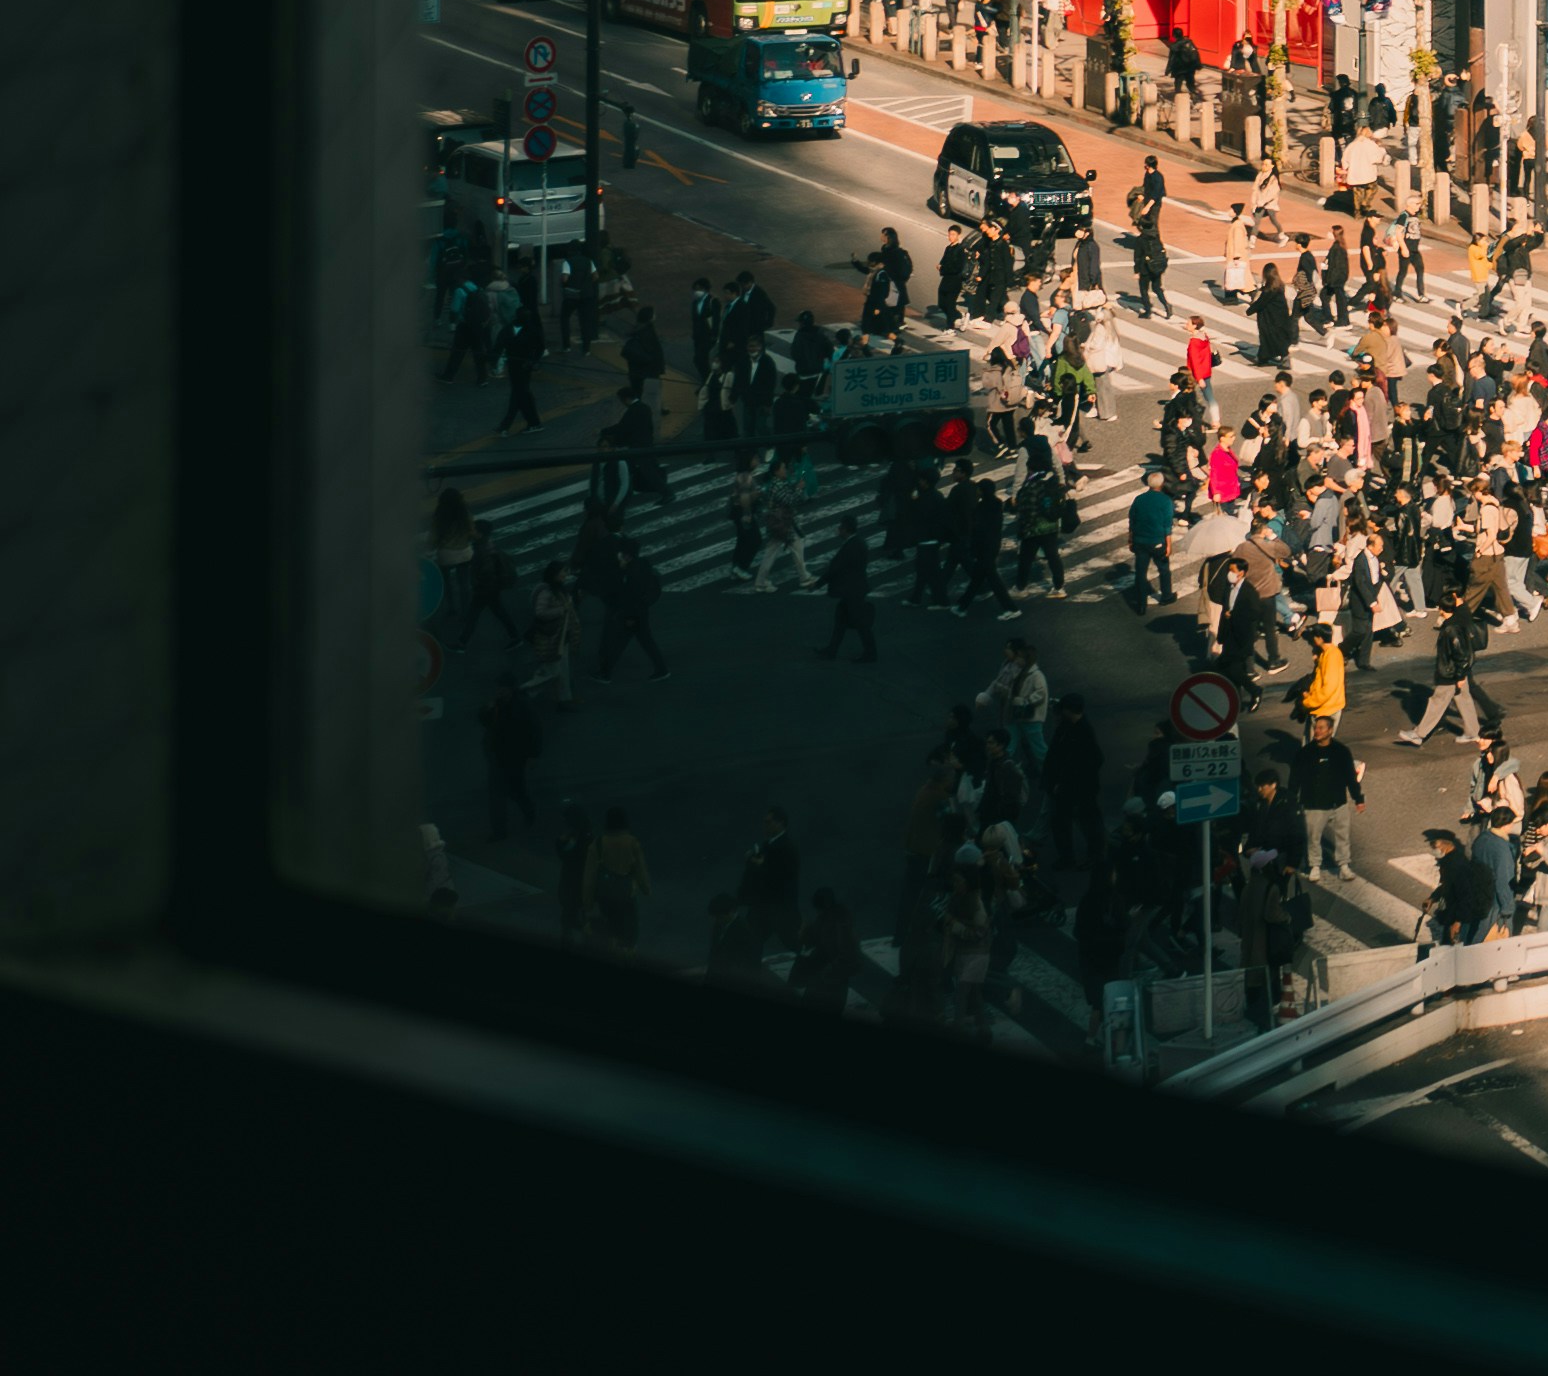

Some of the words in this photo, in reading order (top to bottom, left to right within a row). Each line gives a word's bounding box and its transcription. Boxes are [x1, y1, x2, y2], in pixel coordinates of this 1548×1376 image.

[844, 359, 958, 393] 渋谷駅前
[861, 393, 913, 408] Shibuya
[1182, 763, 1229, 778] 6-22
